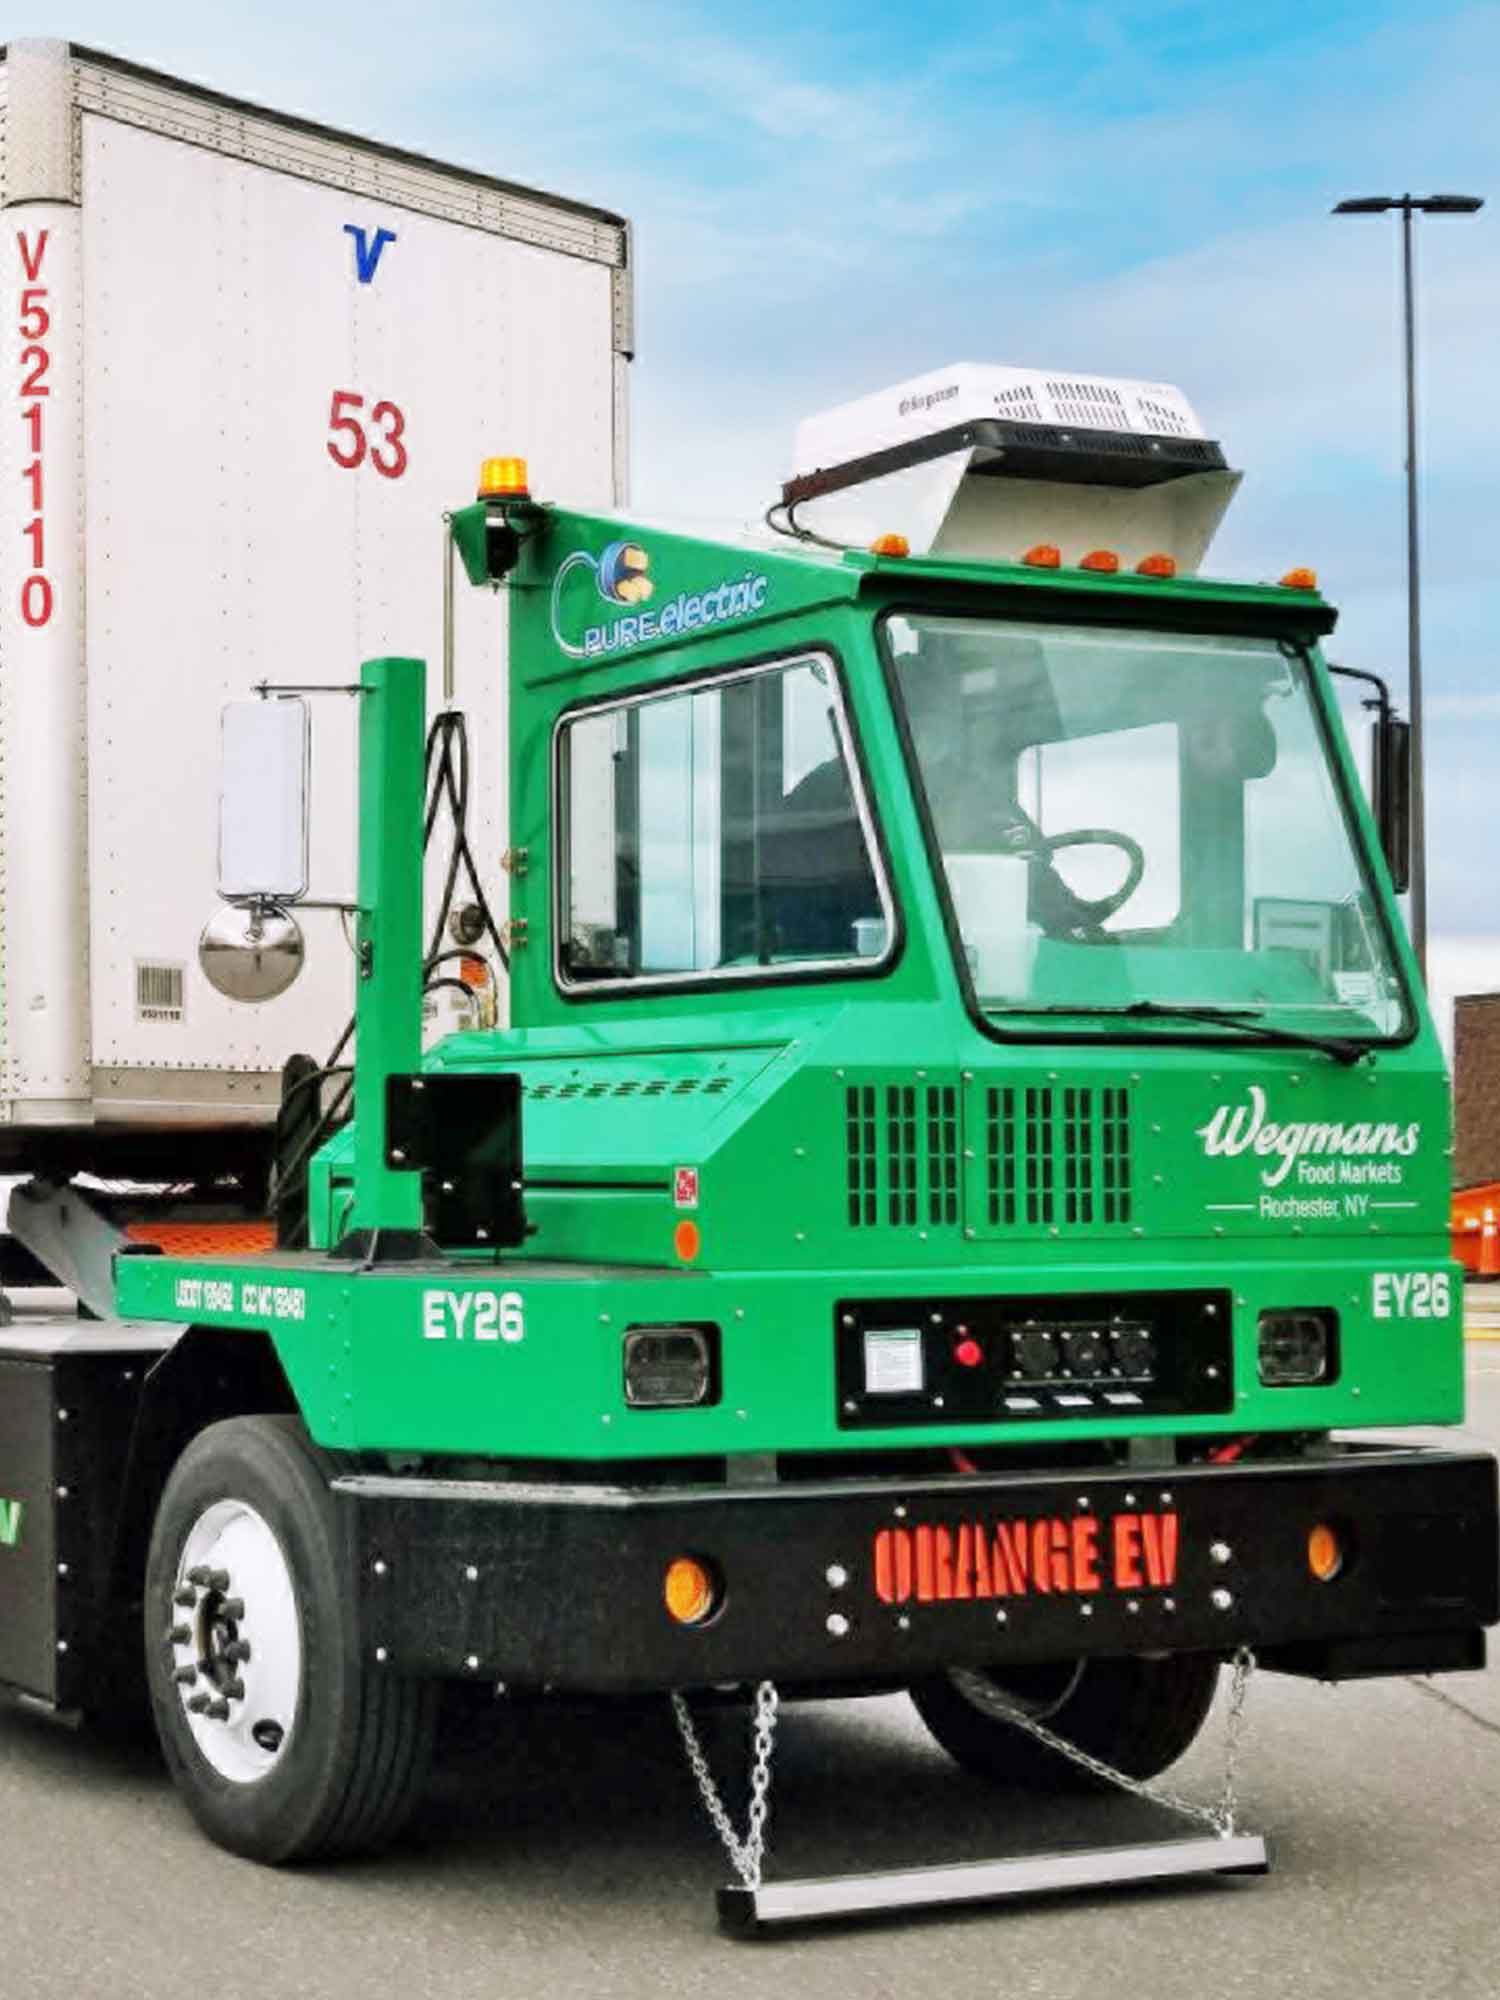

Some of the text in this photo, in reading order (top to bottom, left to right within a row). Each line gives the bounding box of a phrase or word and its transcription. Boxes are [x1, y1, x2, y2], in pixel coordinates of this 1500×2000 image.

[17, 229, 54, 628] V521110
[327, 389, 408, 480] 53
[1195, 1085, 1421, 1188] Wegmans
[1298, 1160, 1402, 1185] Food Markets
[1259, 1194, 1370, 1219] Rochester, NY
[423, 1289, 525, 1343] EY26
[1373, 1272, 1450, 1319] EY26
[874, 1513, 1179, 1604] ORANGE EV
